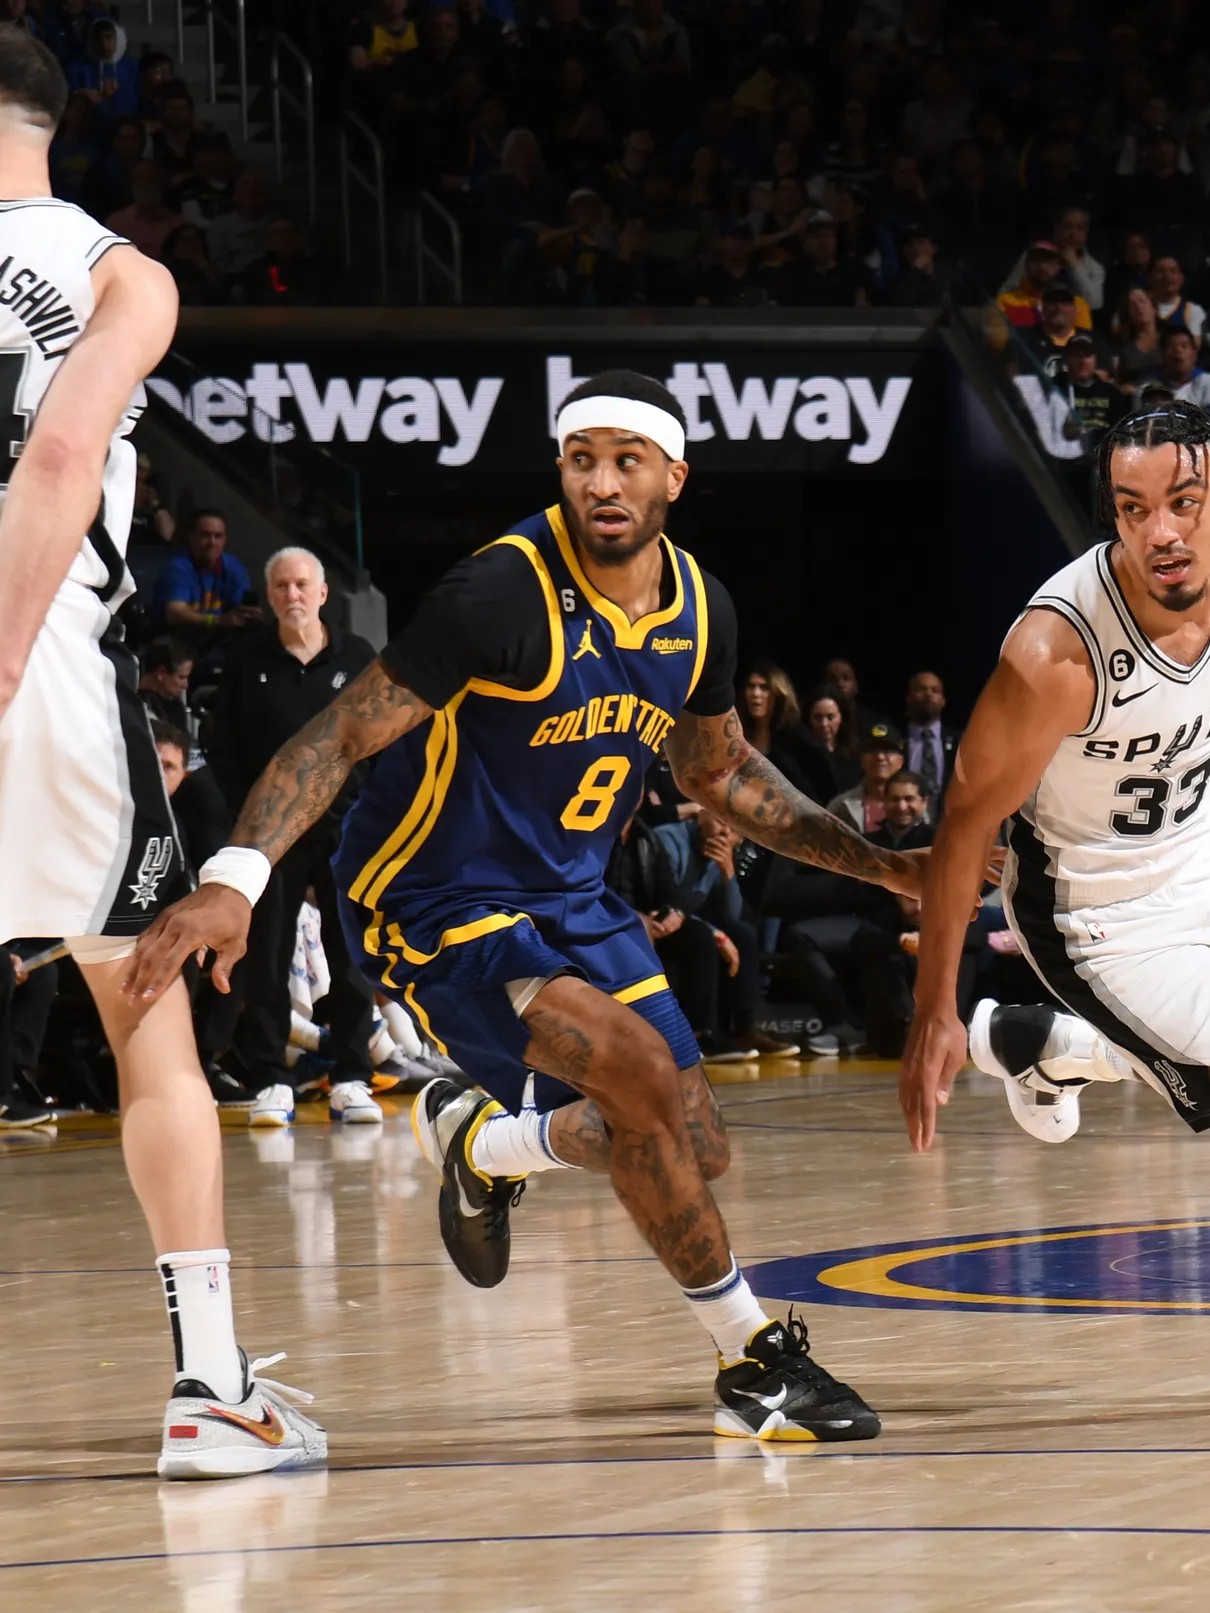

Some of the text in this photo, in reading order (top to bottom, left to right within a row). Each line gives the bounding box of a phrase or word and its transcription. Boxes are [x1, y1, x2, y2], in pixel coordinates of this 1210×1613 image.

[546, 356, 912, 465] btway
[561, 588, 576, 612] 6
[651, 636, 694, 652] Rakuten
[1112, 653, 1131, 679] 6
[529, 694, 676, 754] GOLDEN TATE
[560, 756, 631, 831] 8
[754, 1019, 804, 1034] HASE
